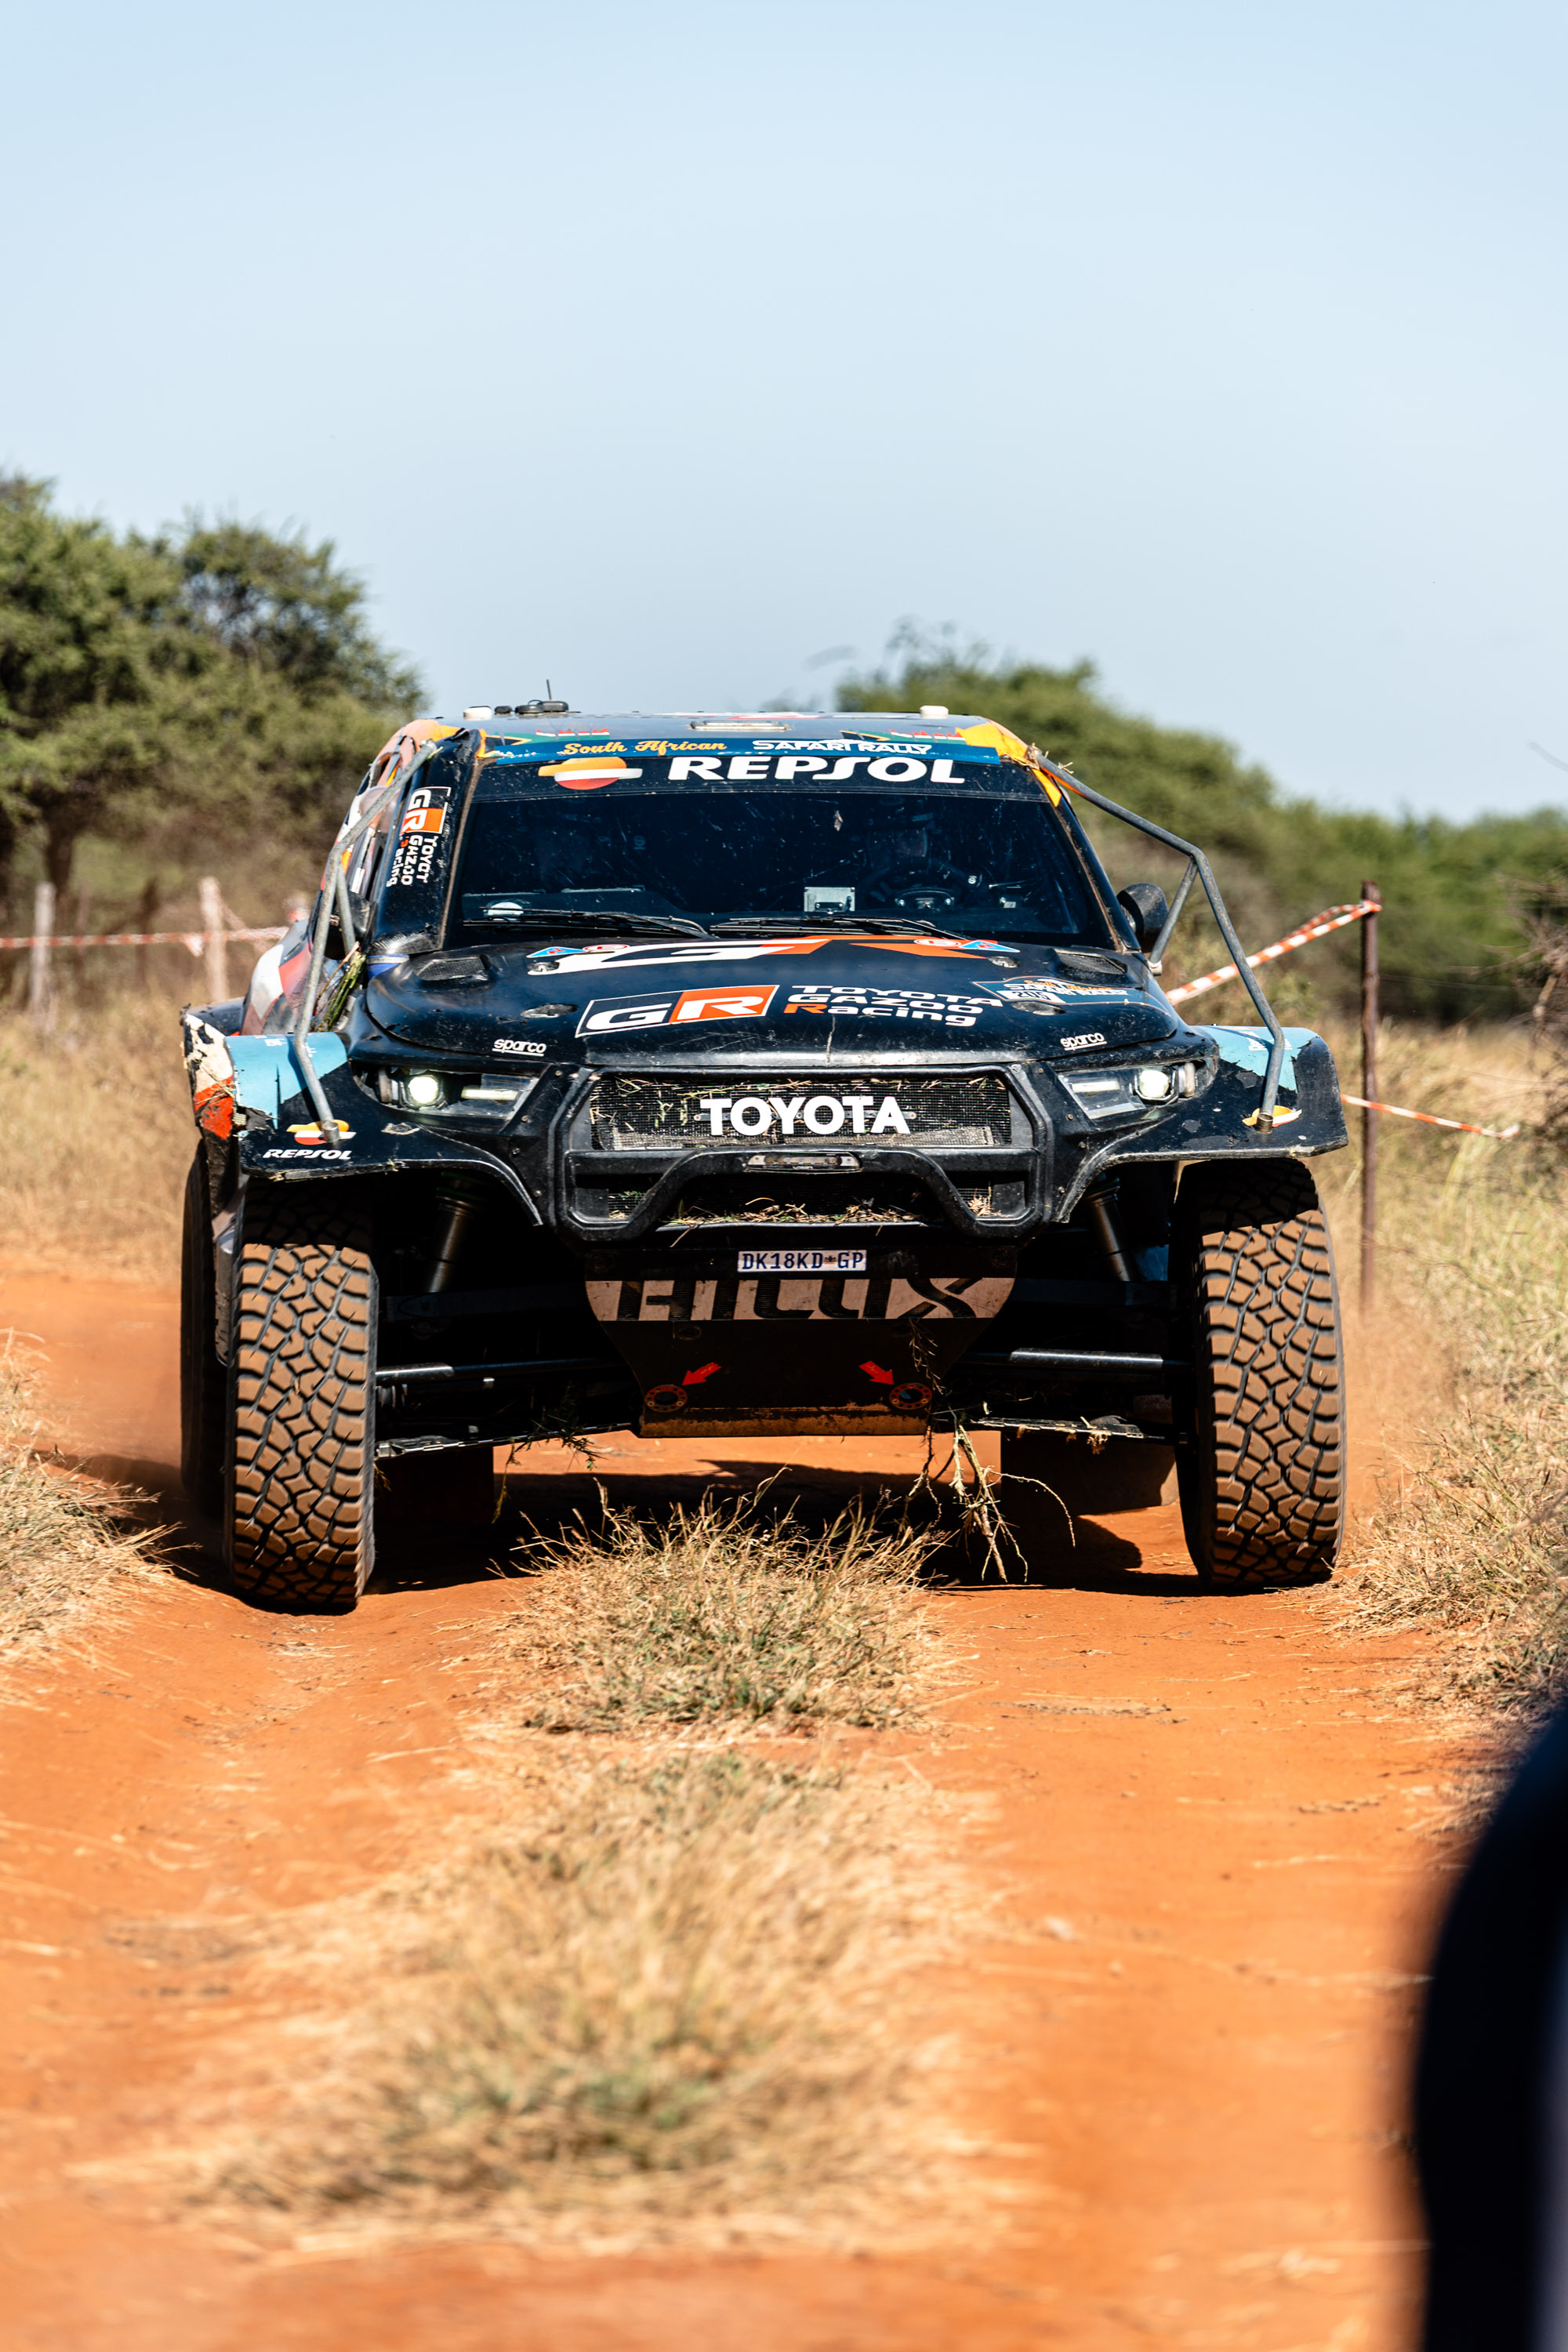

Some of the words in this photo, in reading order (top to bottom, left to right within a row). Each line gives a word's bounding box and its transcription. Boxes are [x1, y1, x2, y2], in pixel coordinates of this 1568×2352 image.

[563, 741, 627, 755] South
[634, 740, 728, 756] African
[752, 739, 851, 752] SAFARI
[858, 741, 932, 755] RALLY
[667, 755, 966, 784] REPSOL
[402, 789, 432, 833] GR
[788, 993, 983, 1014] GAZOO
[792, 985, 1004, 1007] TOYOTA
[586, 996, 764, 1030] GR
[783, 1004, 977, 1027] Racing
[494, 1038, 547, 1056] sparco
[1060, 1033, 1105, 1050] sparco
[699, 1095, 911, 1136] TOYOTA
[263, 1149, 352, 1160] REPSOL
[742, 1253, 823, 1270] DK18KD
[837, 1252, 864, 1269] GP
